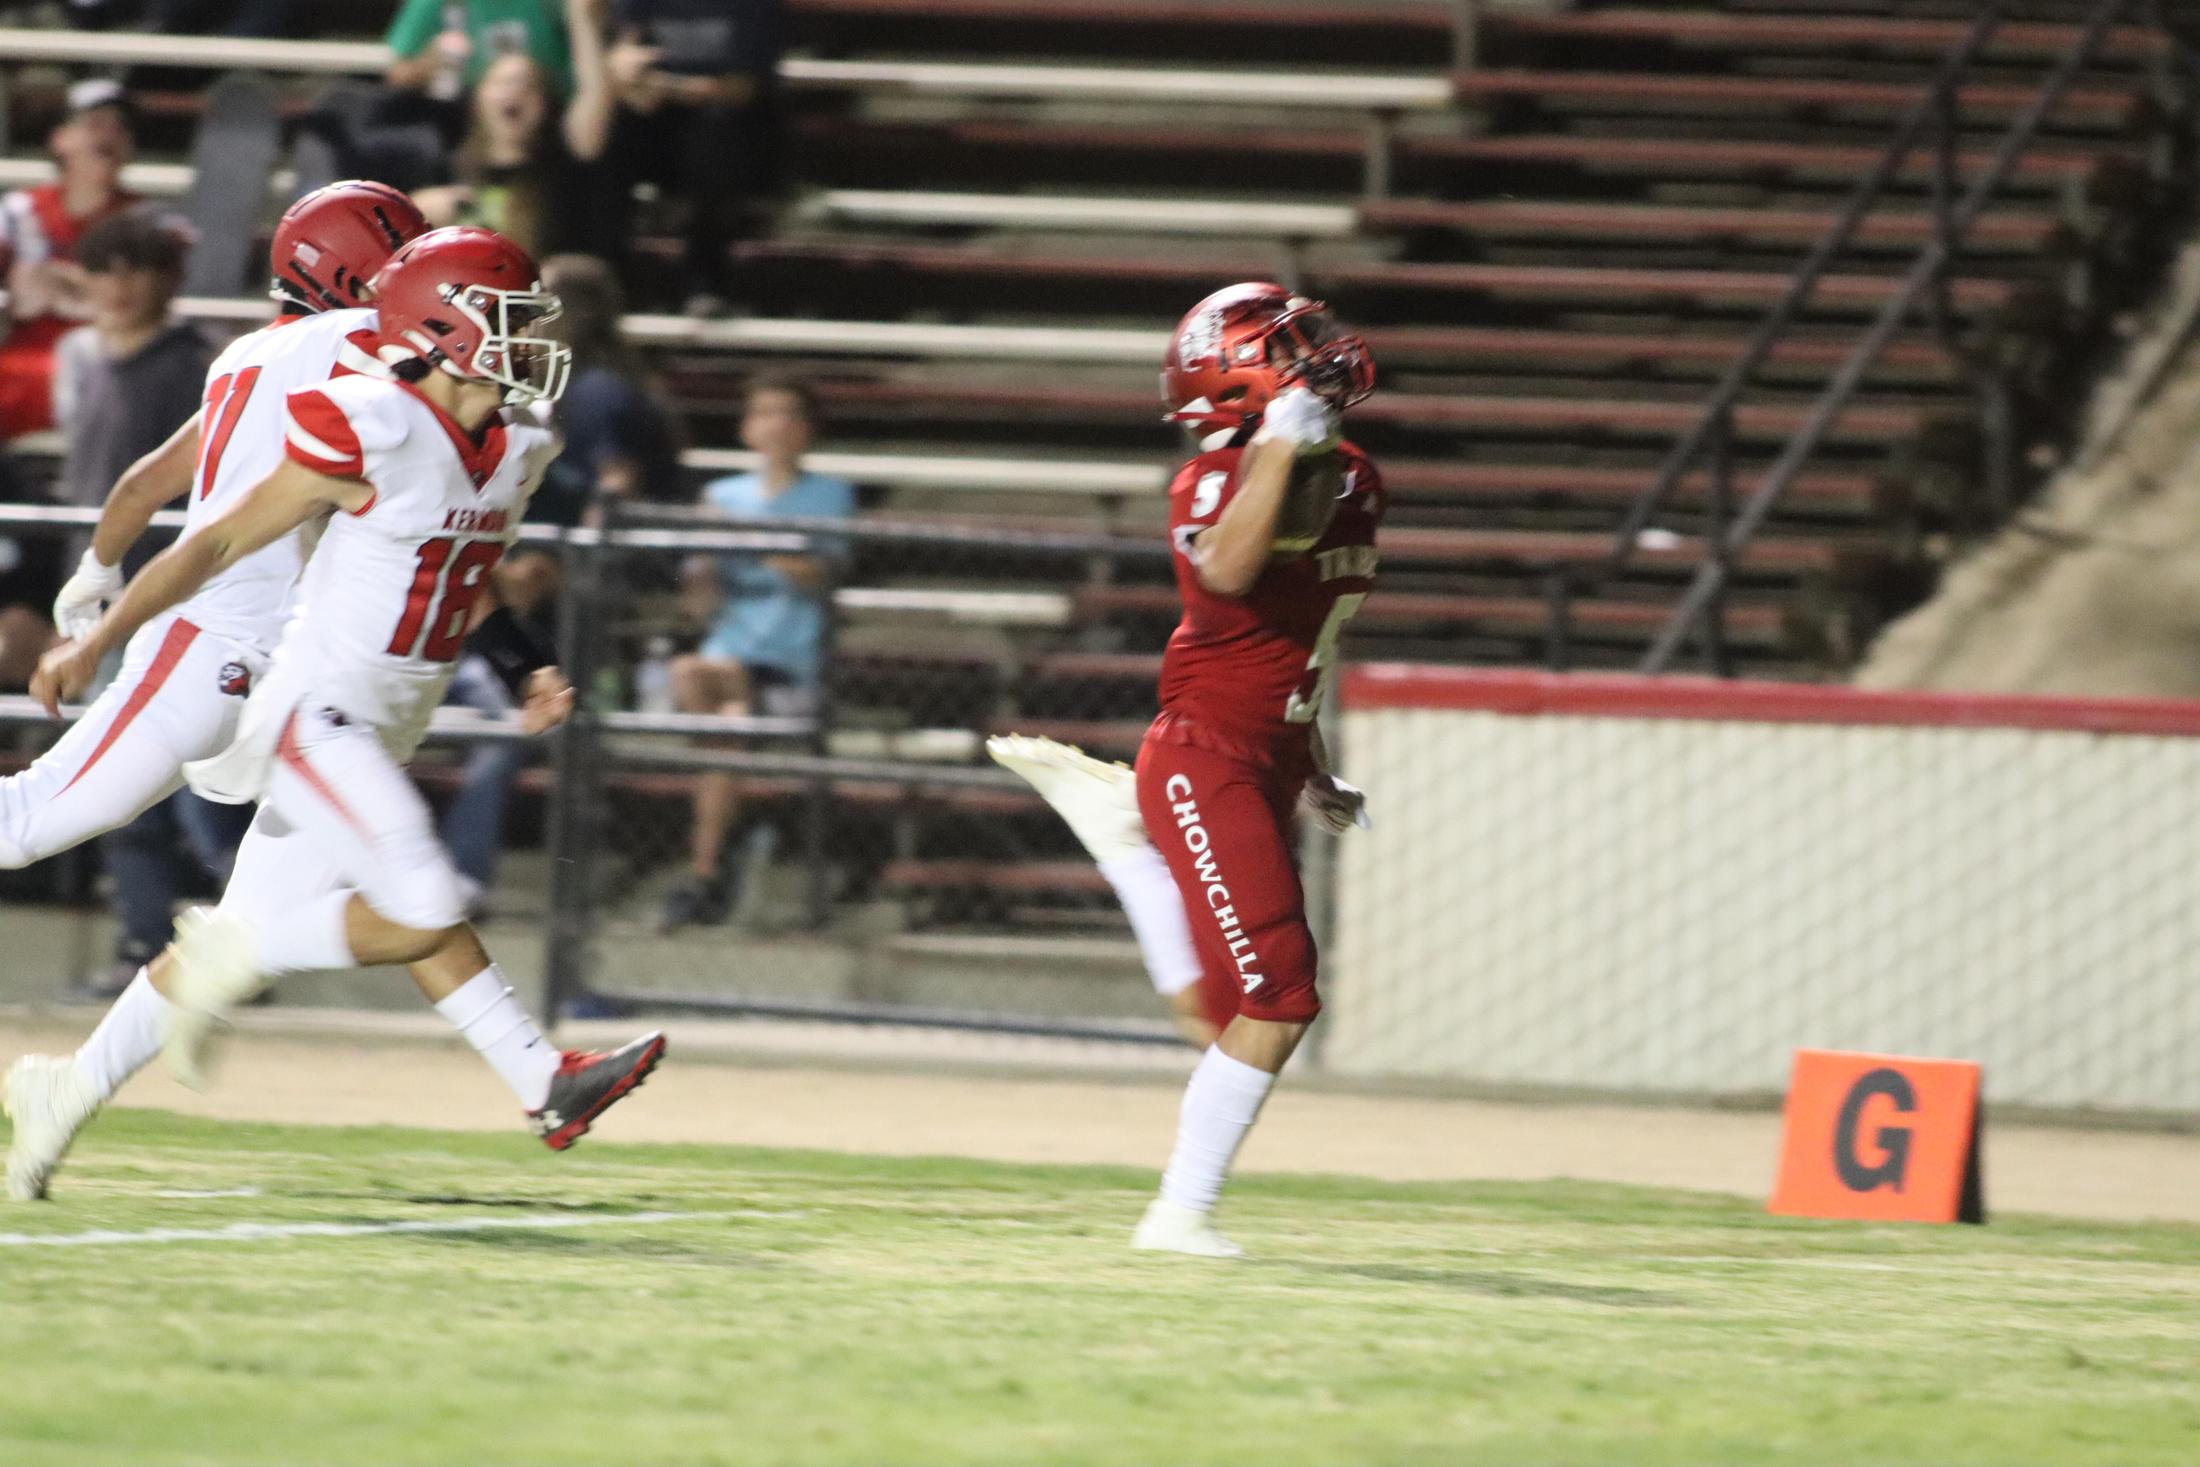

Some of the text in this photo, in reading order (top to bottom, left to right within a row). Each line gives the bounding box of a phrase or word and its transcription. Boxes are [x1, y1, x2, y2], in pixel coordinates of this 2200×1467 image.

[194, 365, 263, 502] 11
[384, 537, 504, 663] 18
[1165, 773, 1265, 994] CHOWCHILLA
[1833, 1068, 1918, 1193] G
